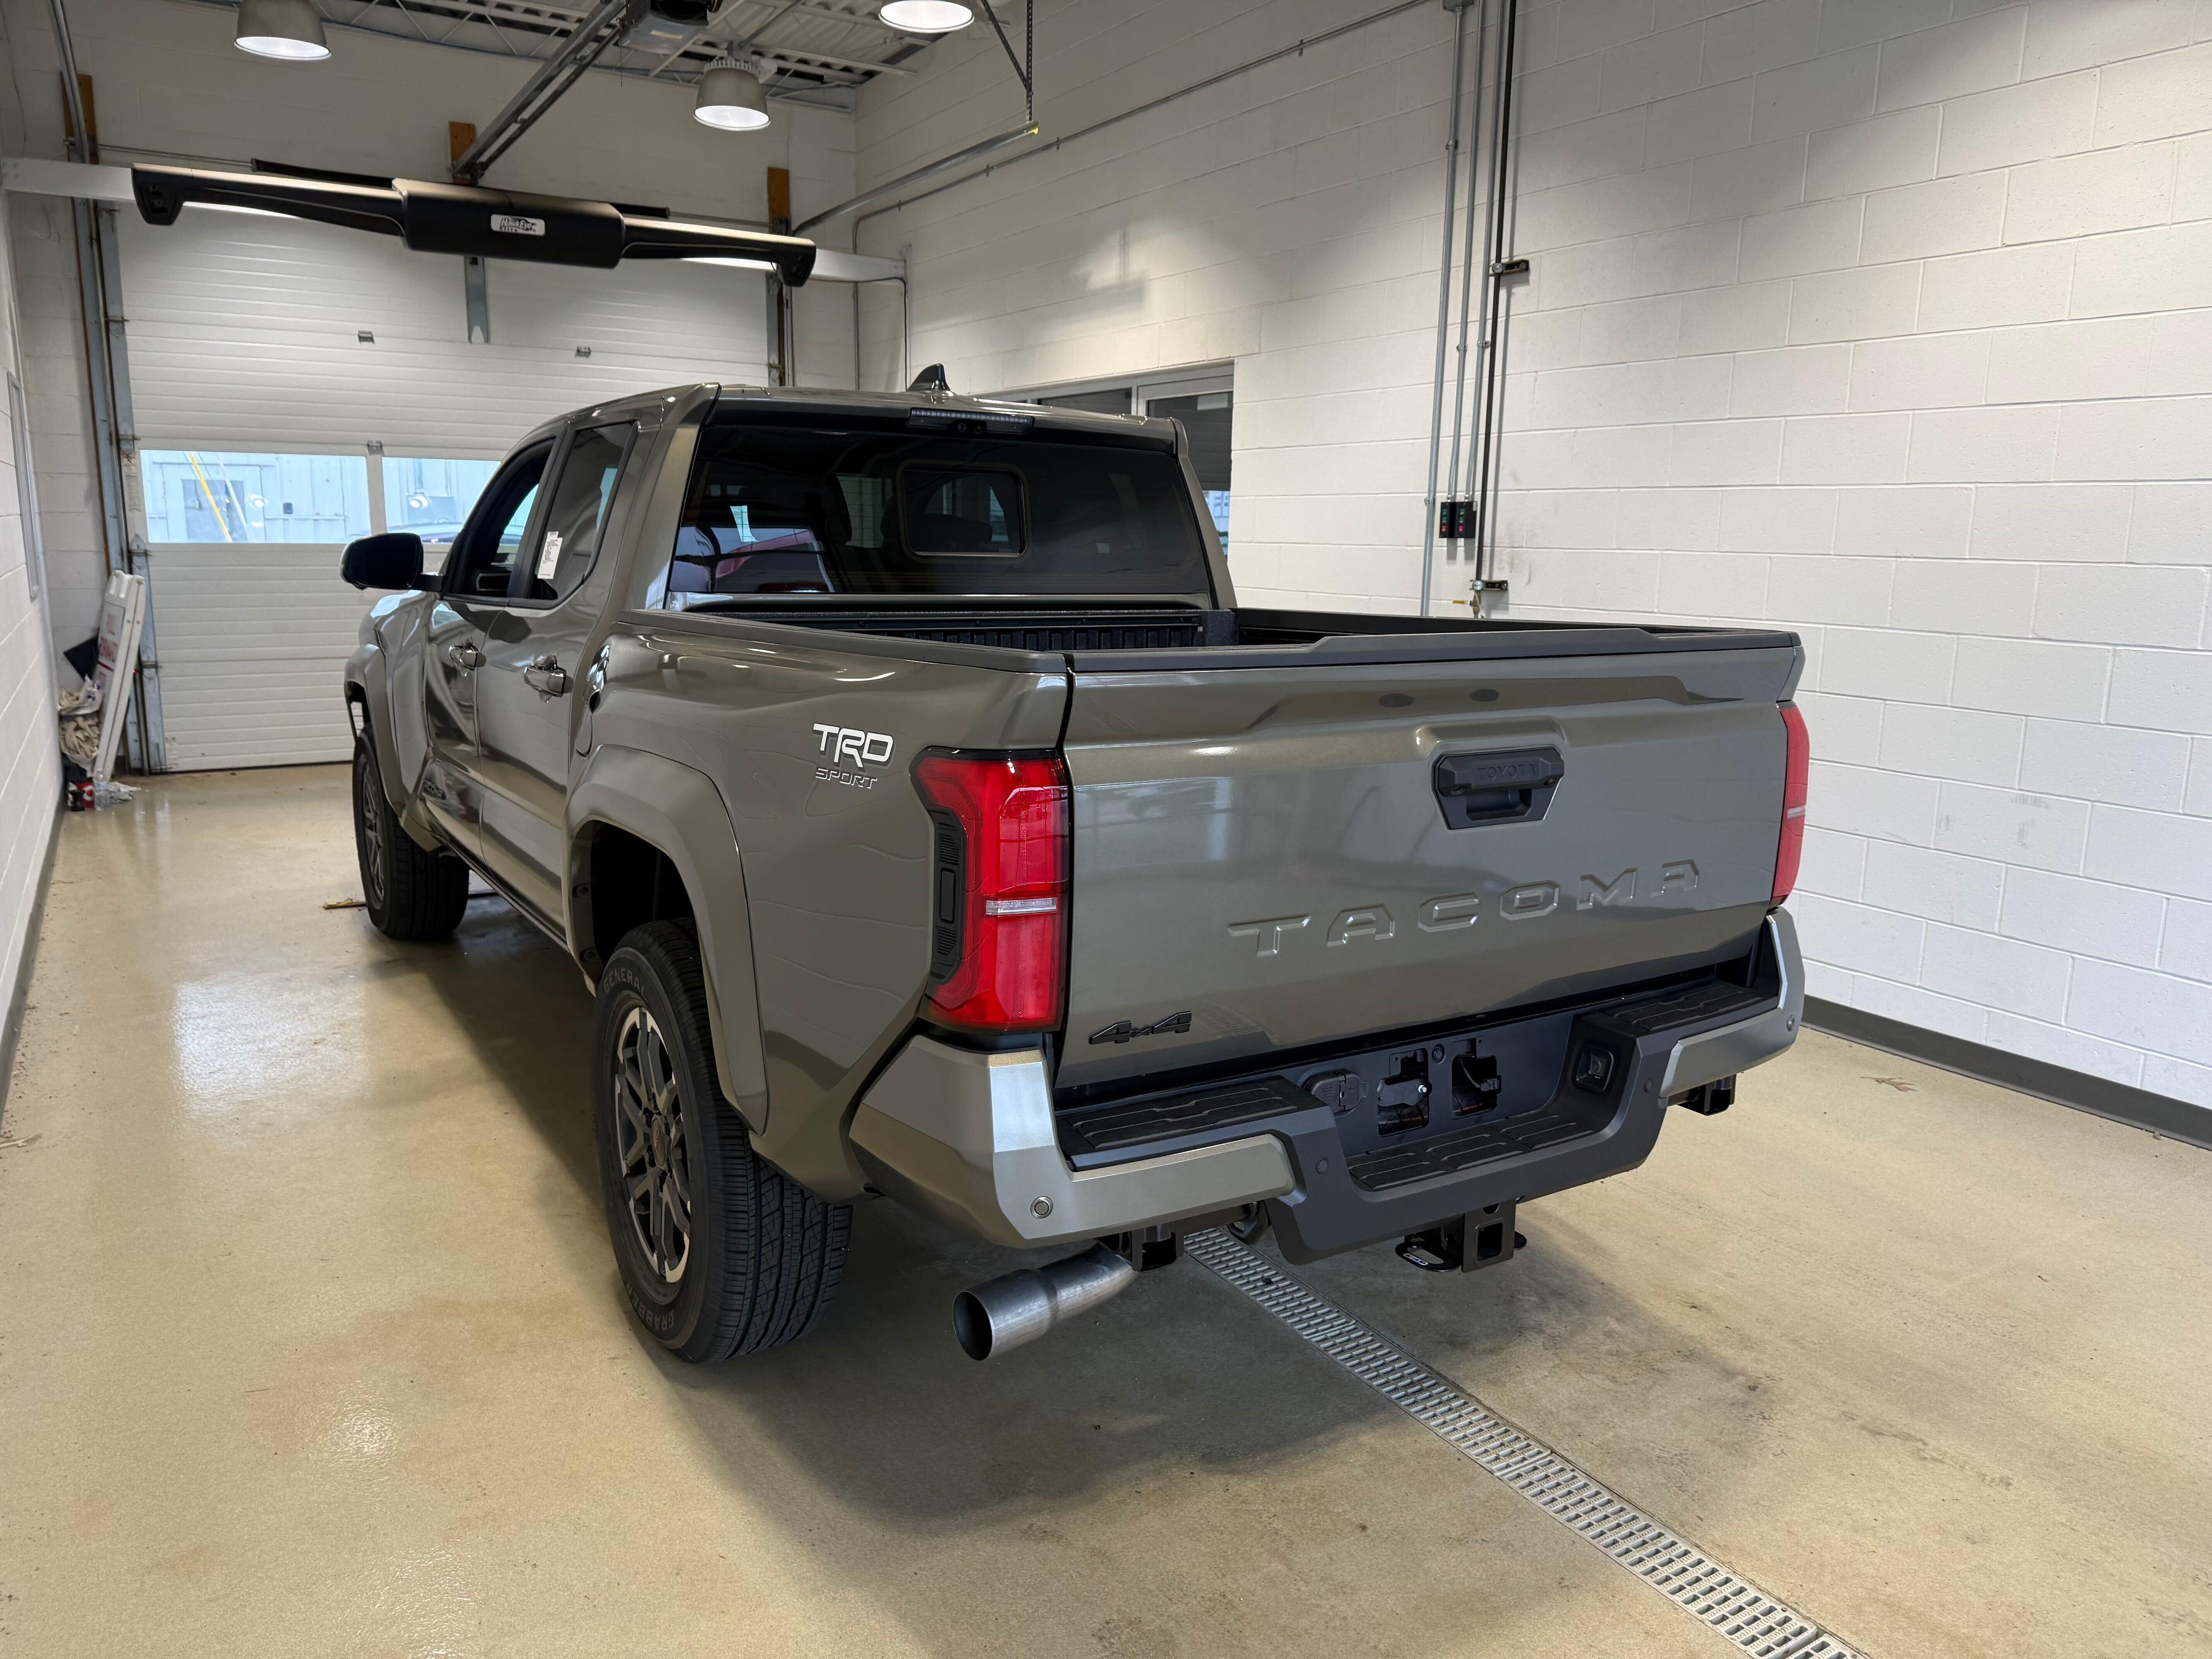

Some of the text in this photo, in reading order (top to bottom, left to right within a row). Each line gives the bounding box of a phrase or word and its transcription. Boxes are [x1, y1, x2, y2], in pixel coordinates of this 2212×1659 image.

[813, 723, 893, 768] TRD
[815, 767, 878, 789] SPORT
[1477, 763, 1536, 781] TOYOTA
[1227, 859, 1700, 957] TACOMA
[604, 967, 648, 1002] GENERAL
[1089, 1010, 1192, 1045] 4x4
